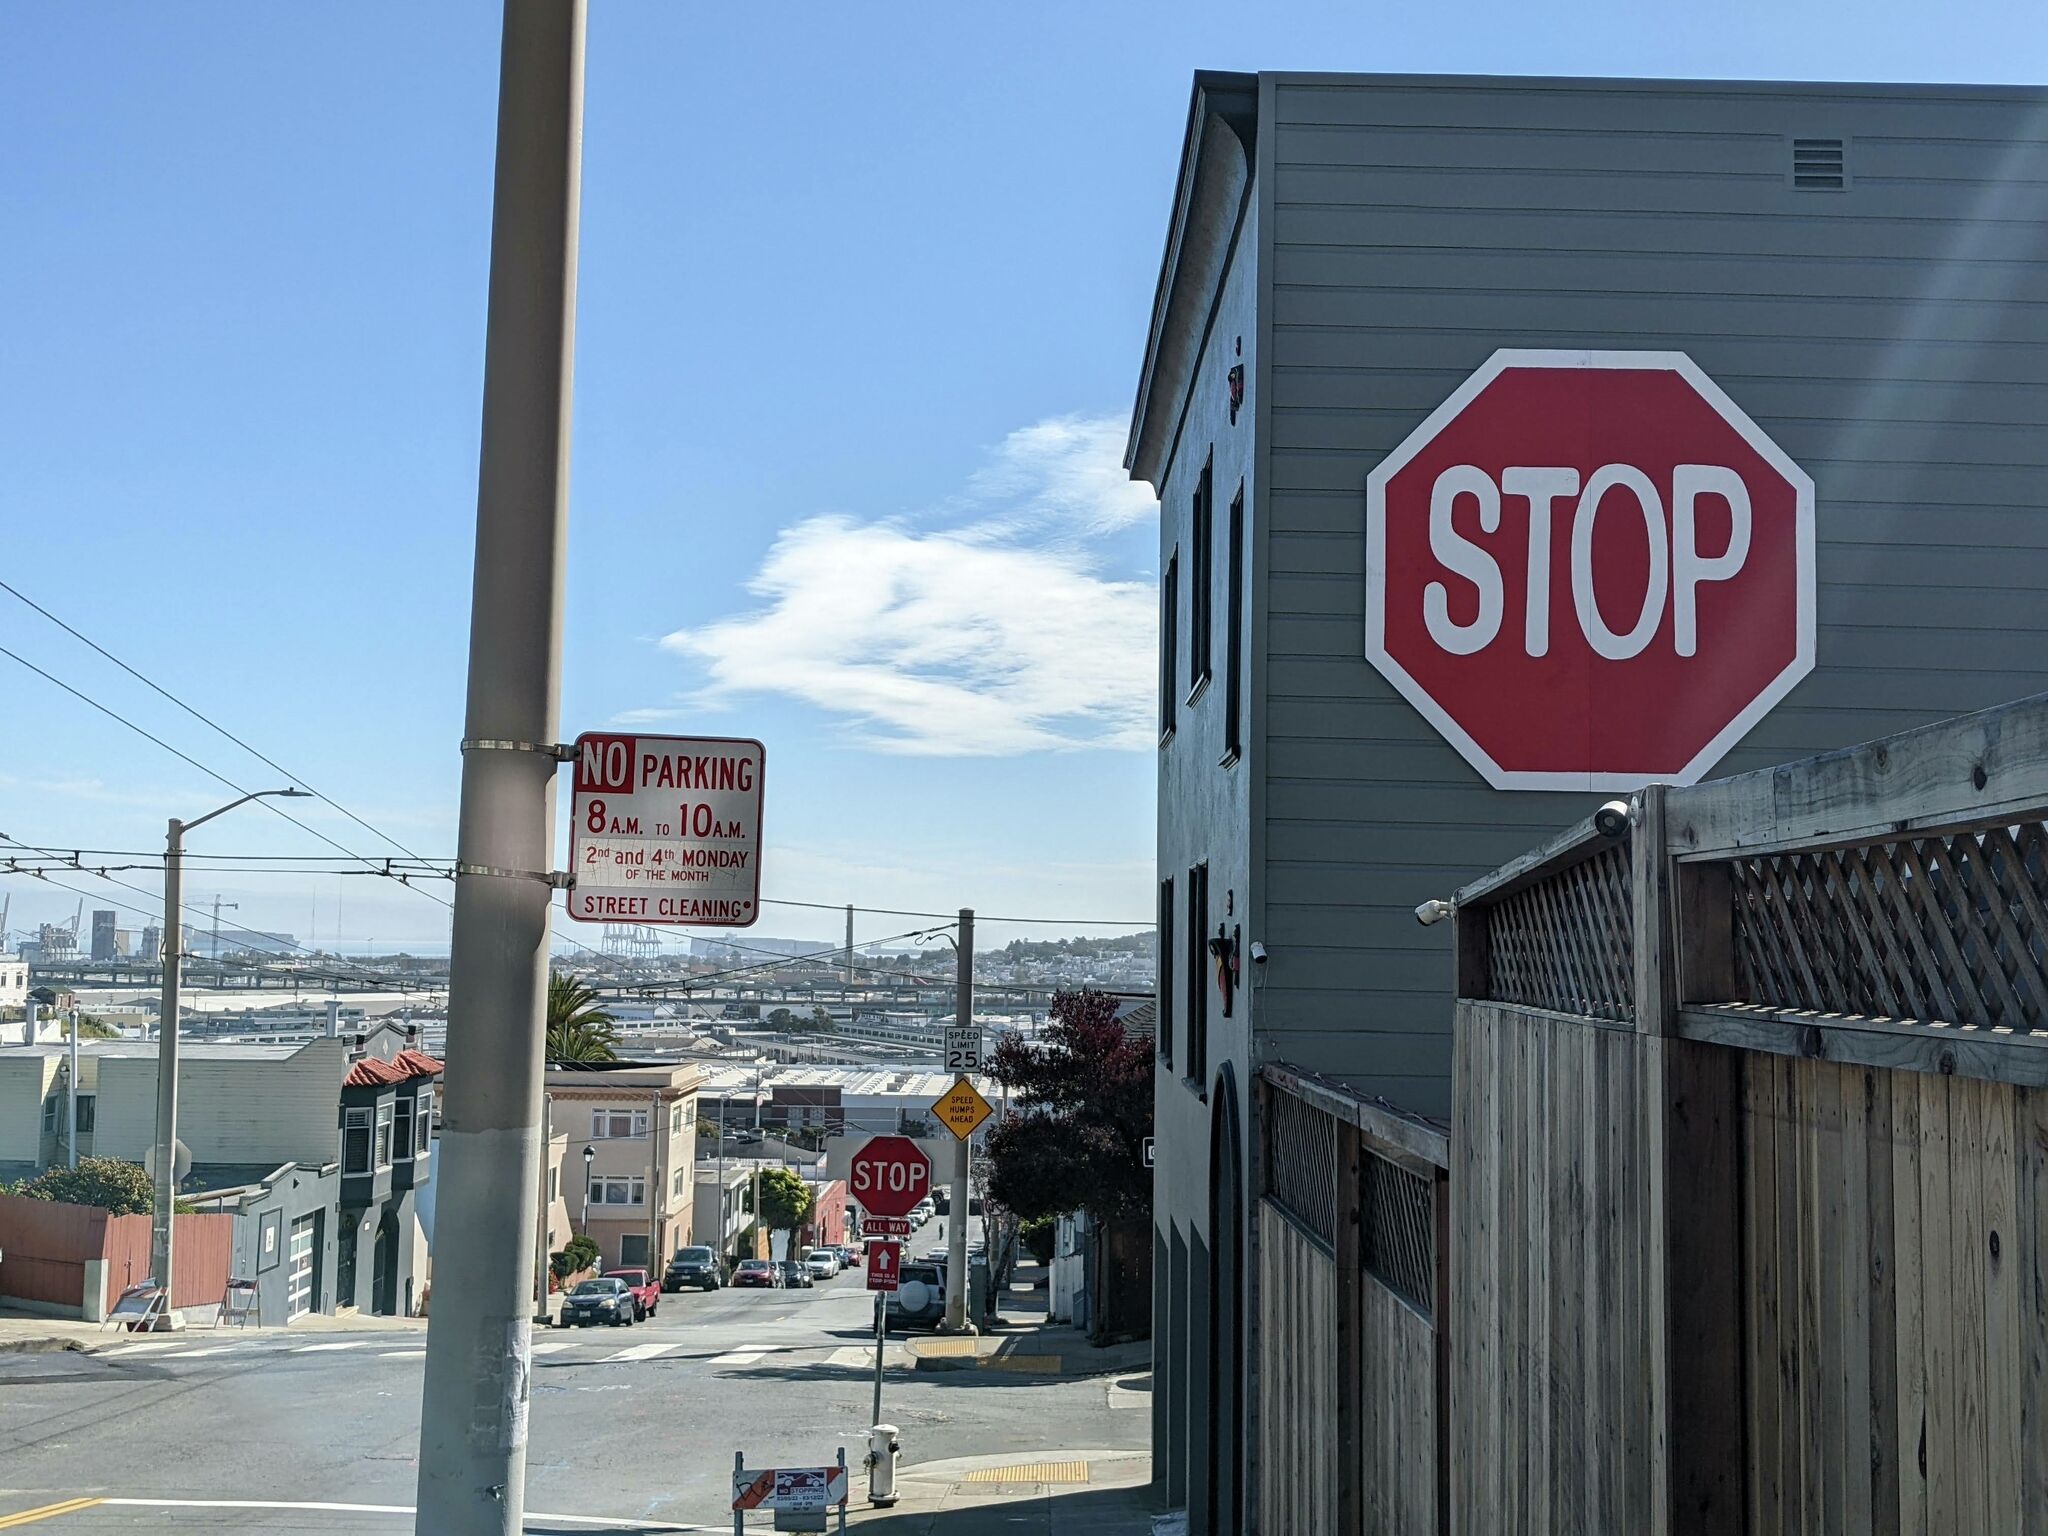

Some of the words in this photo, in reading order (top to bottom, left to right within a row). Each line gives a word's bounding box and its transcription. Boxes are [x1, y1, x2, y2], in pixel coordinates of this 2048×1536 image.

[1423, 463, 1752, 660] STOP
[582, 741, 628, 787] NO
[642, 755, 753, 792] PARKING
[587, 799, 607, 834] 8
[610, 816, 644, 835] A.M.
[656, 823, 670, 836] TO
[680, 803, 713, 838] 10
[712, 821, 746, 839] A.M.
[586, 846, 610, 865] 2nd
[615, 849, 644, 866] and
[651, 849, 675, 866] 4th
[682, 849, 749, 869] MONDAY
[625, 869, 642, 881] OF
[646, 870, 666, 881] THE
[671, 870, 709, 882] MONTH
[584, 896, 649, 915] STREET
[658, 898, 742, 918] CLEANING
[948, 1031, 979, 1040] SPEED
[951, 1041, 976, 1049] LIMIT
[949, 1051, 977, 1068] 25
[951, 1096, 974, 1104] SPEED
[949, 1105, 975, 1113] HUMPS
[949, 1115, 974, 1123] AHEAD
[854, 1160, 926, 1192] STOP
[866, 1222, 884, 1232] ALL
[888, 1222, 907, 1233] WAY
